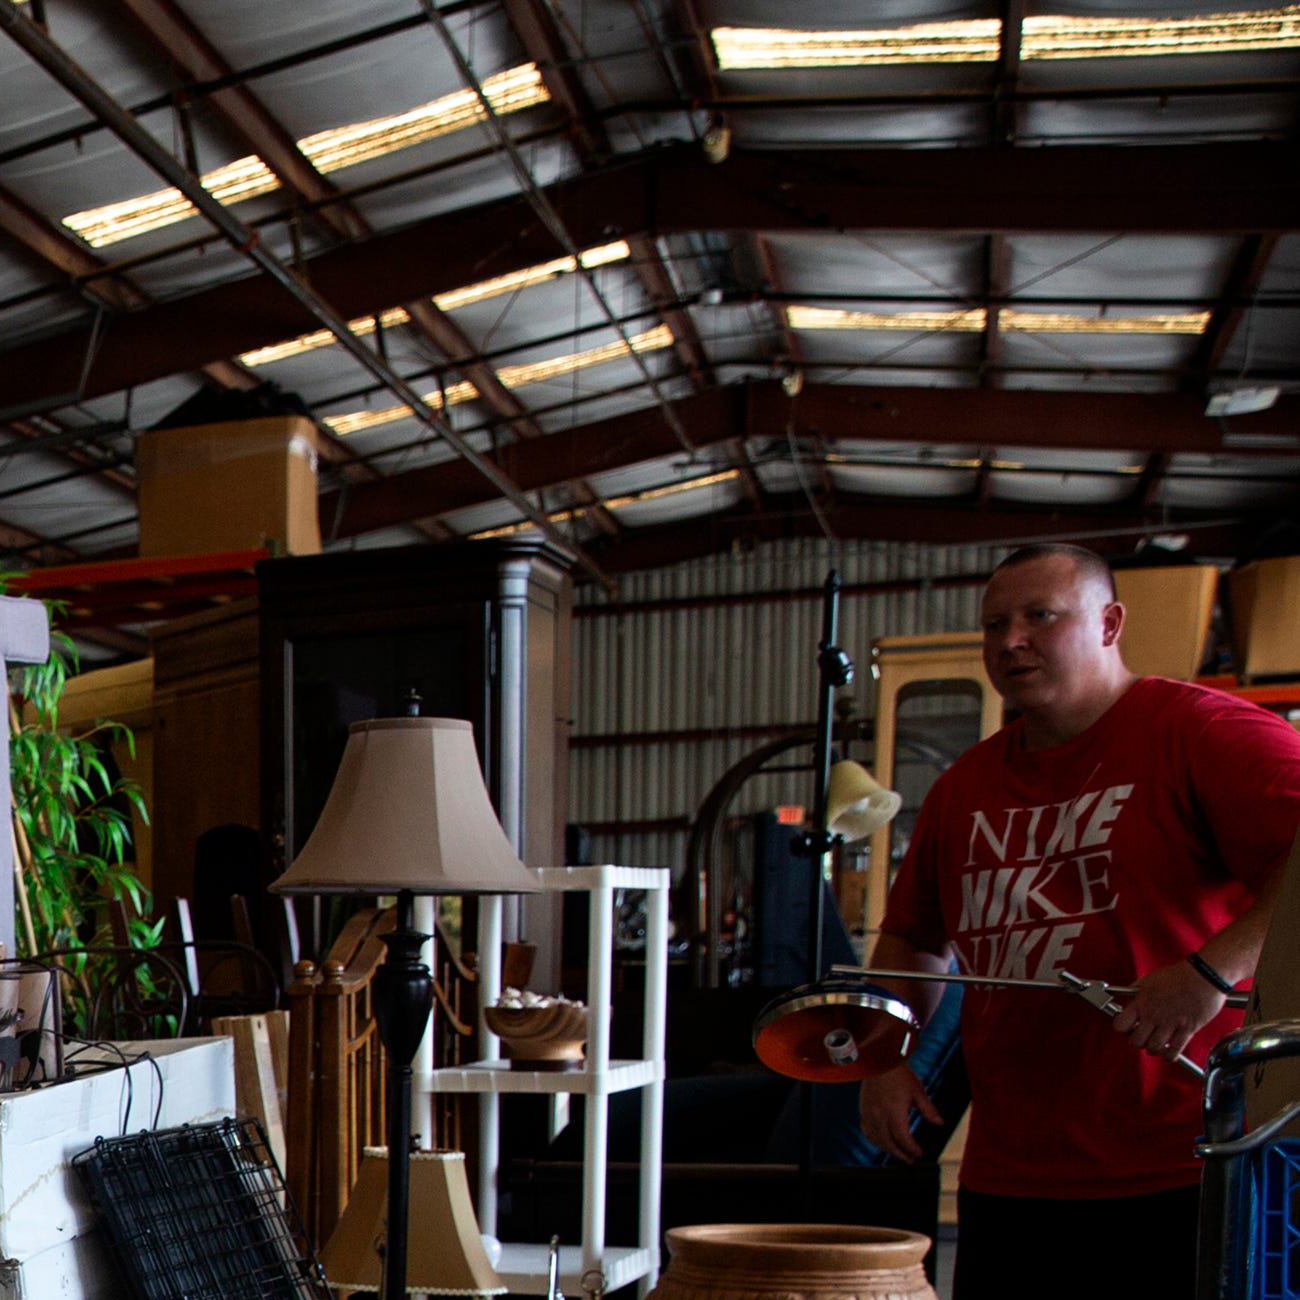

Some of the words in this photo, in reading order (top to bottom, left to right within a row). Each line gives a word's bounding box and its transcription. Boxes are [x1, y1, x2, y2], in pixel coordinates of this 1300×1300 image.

[964, 783, 1135, 867] NIKE
[956, 851, 1120, 932] NIKE
[950, 921, 1085, 990] NIKE
